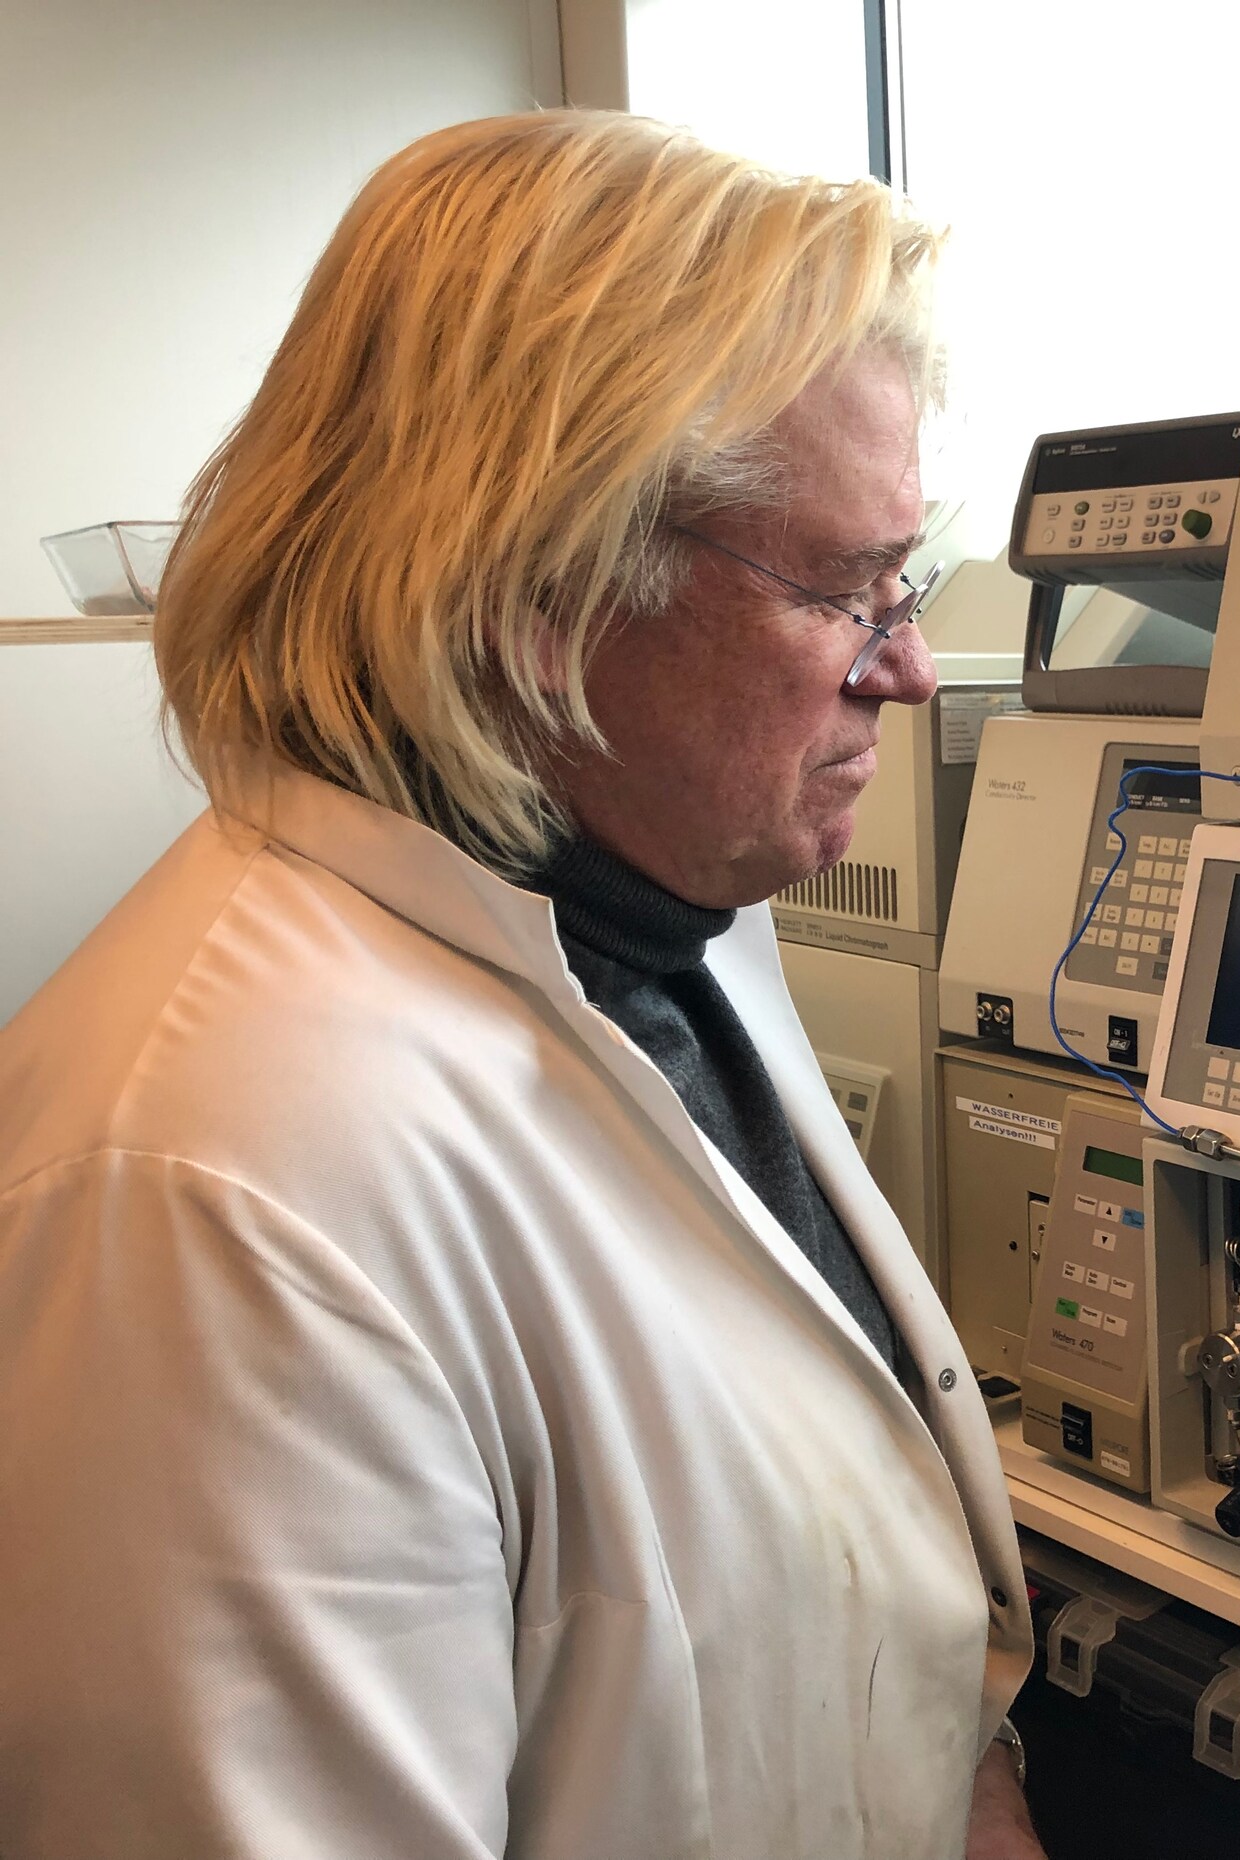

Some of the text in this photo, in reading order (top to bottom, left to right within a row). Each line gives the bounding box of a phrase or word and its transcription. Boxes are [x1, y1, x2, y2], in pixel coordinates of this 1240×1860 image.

[1012, 781, 1026, 792] 432
[972, 1103, 1059, 1131] WASSERFREIE
[974, 1120, 1037, 1142] Analysen!!!
[1052, 1328, 1094, 1352] Waters 470
